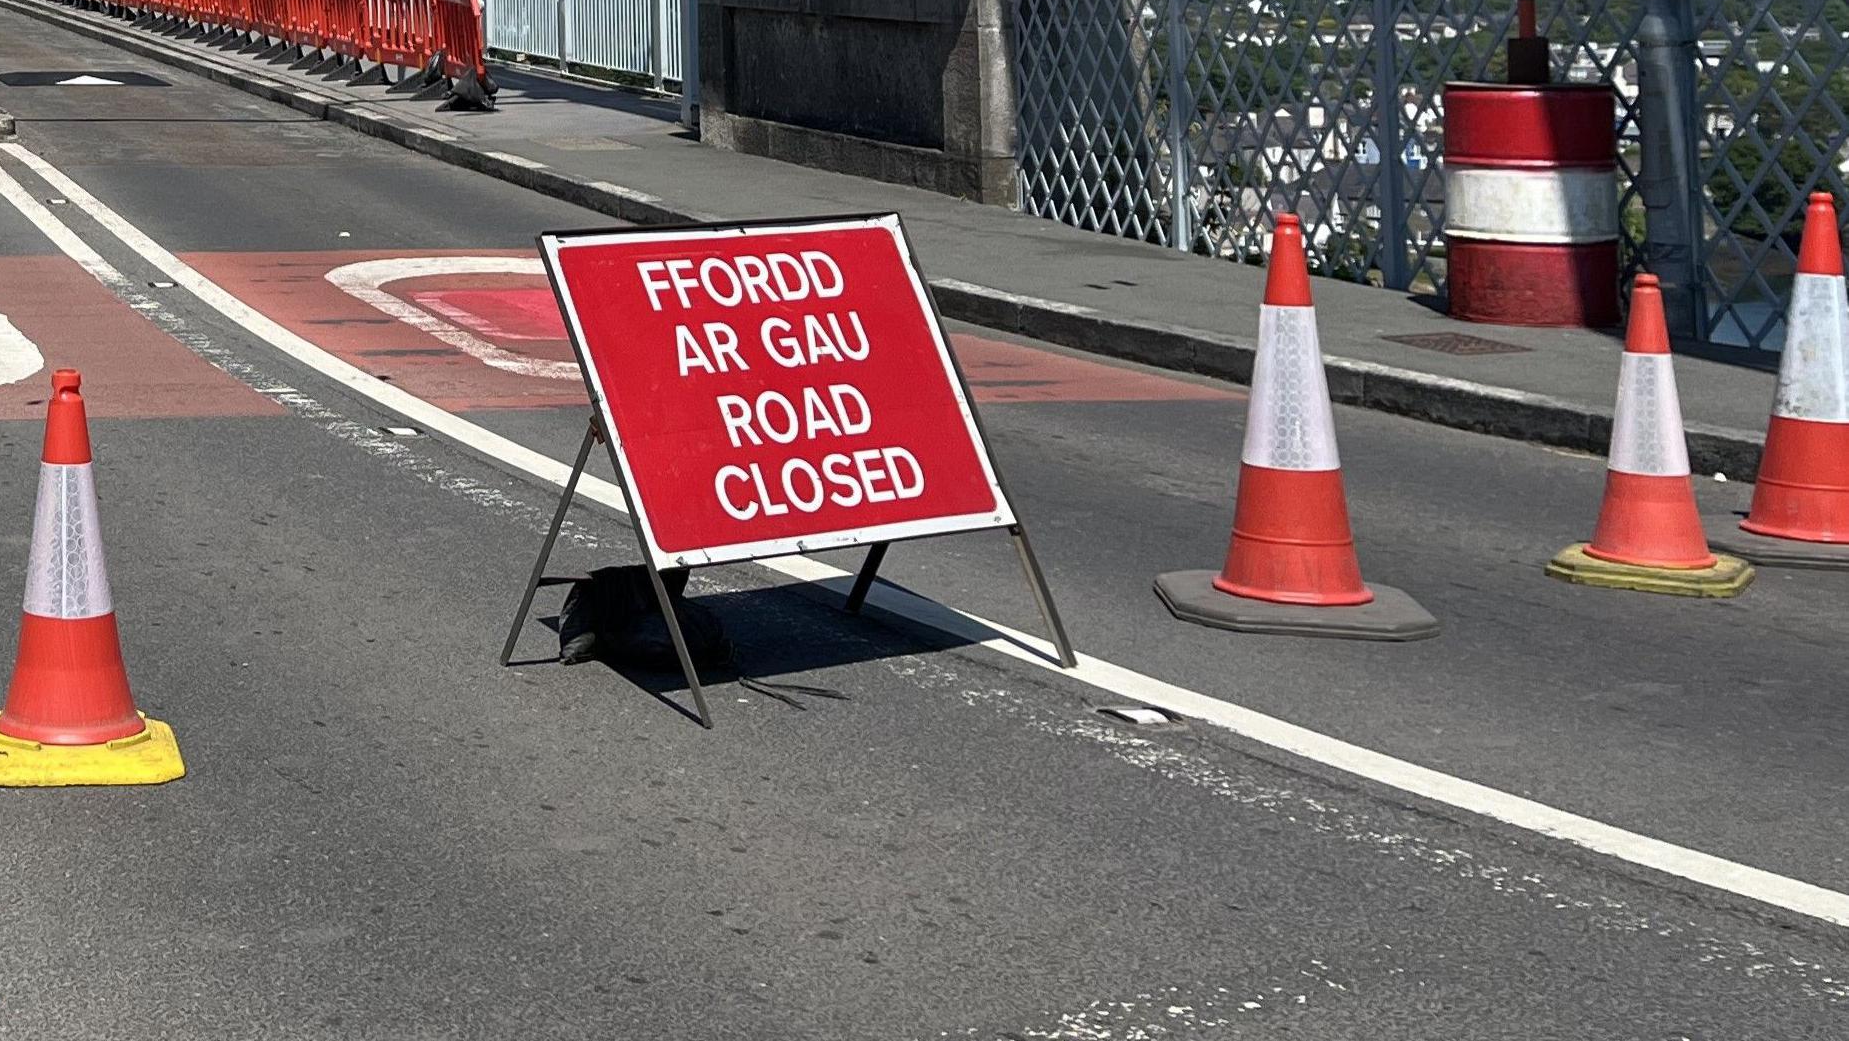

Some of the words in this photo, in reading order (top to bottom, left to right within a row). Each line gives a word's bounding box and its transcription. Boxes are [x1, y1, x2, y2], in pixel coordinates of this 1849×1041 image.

[636, 250, 845, 311] FFORDD
[674, 322, 750, 377] AR
[759, 311, 870, 368] GAU
[716, 383, 872, 448] ROAD
[714, 446, 926, 521] CLOSED
